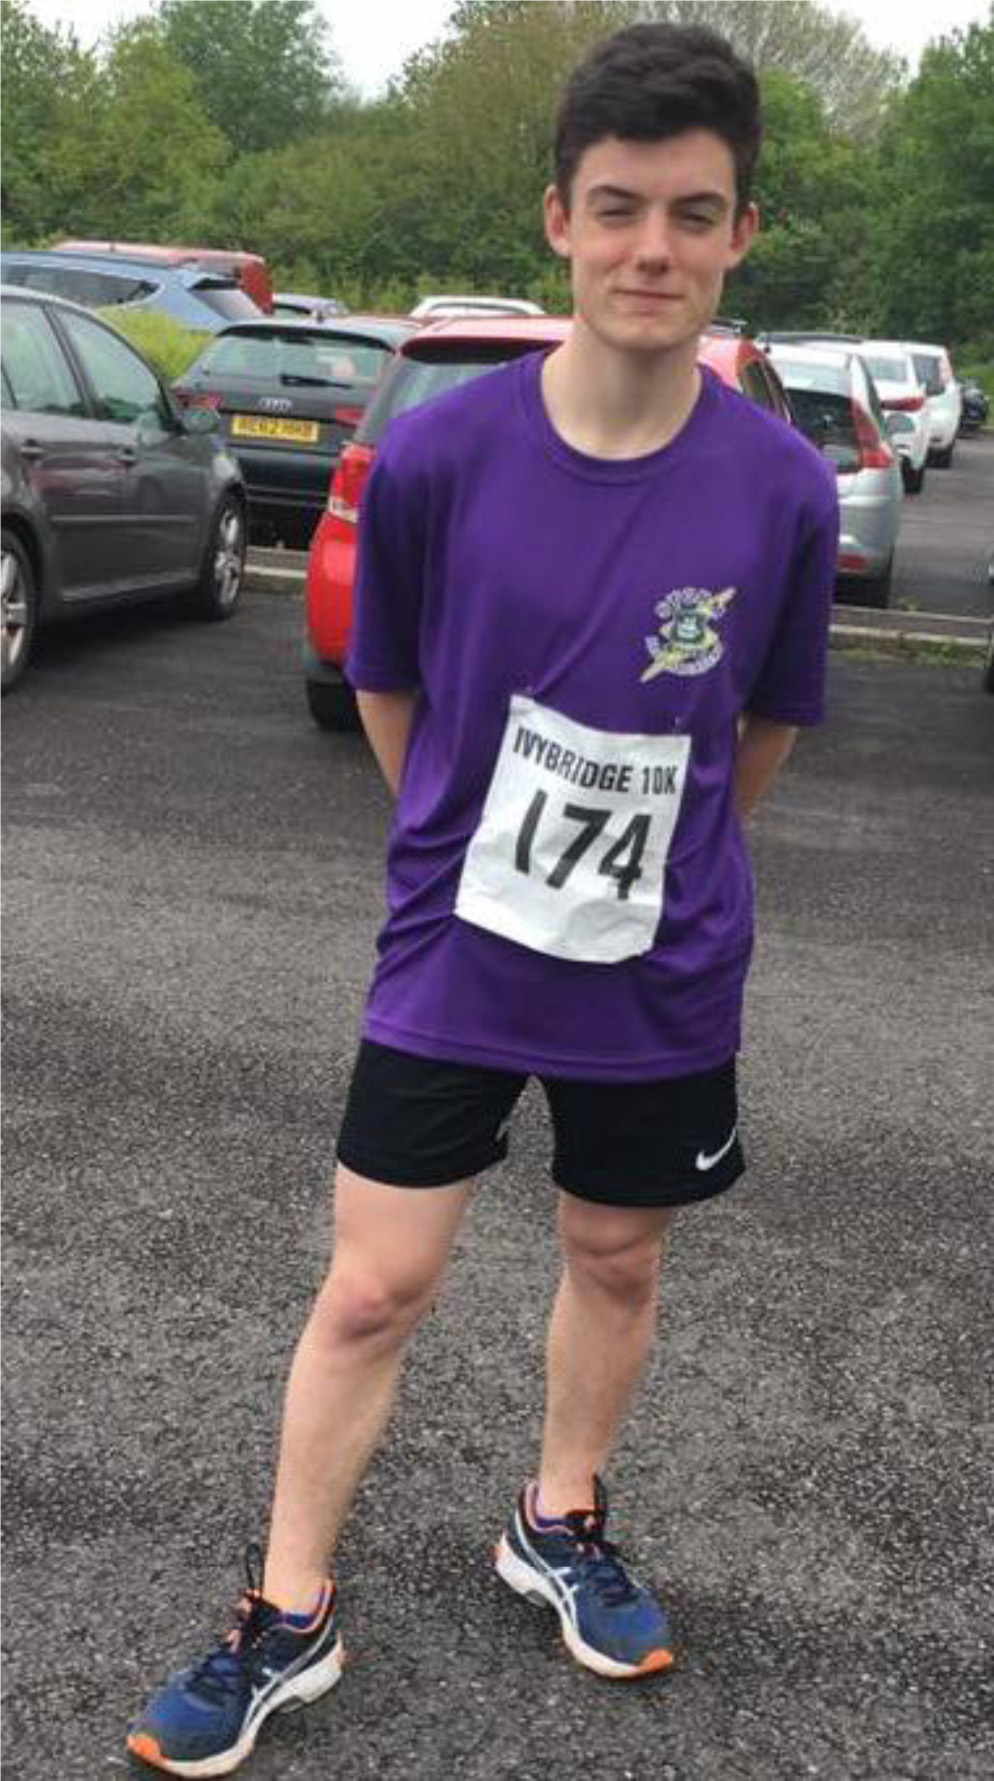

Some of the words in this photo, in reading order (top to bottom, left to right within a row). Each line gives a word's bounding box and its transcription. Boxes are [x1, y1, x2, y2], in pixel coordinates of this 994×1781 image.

[513, 726, 633, 792] IVYBRIDGE
[642, 765, 678, 795] 10K
[515, 788, 652, 901] 174
